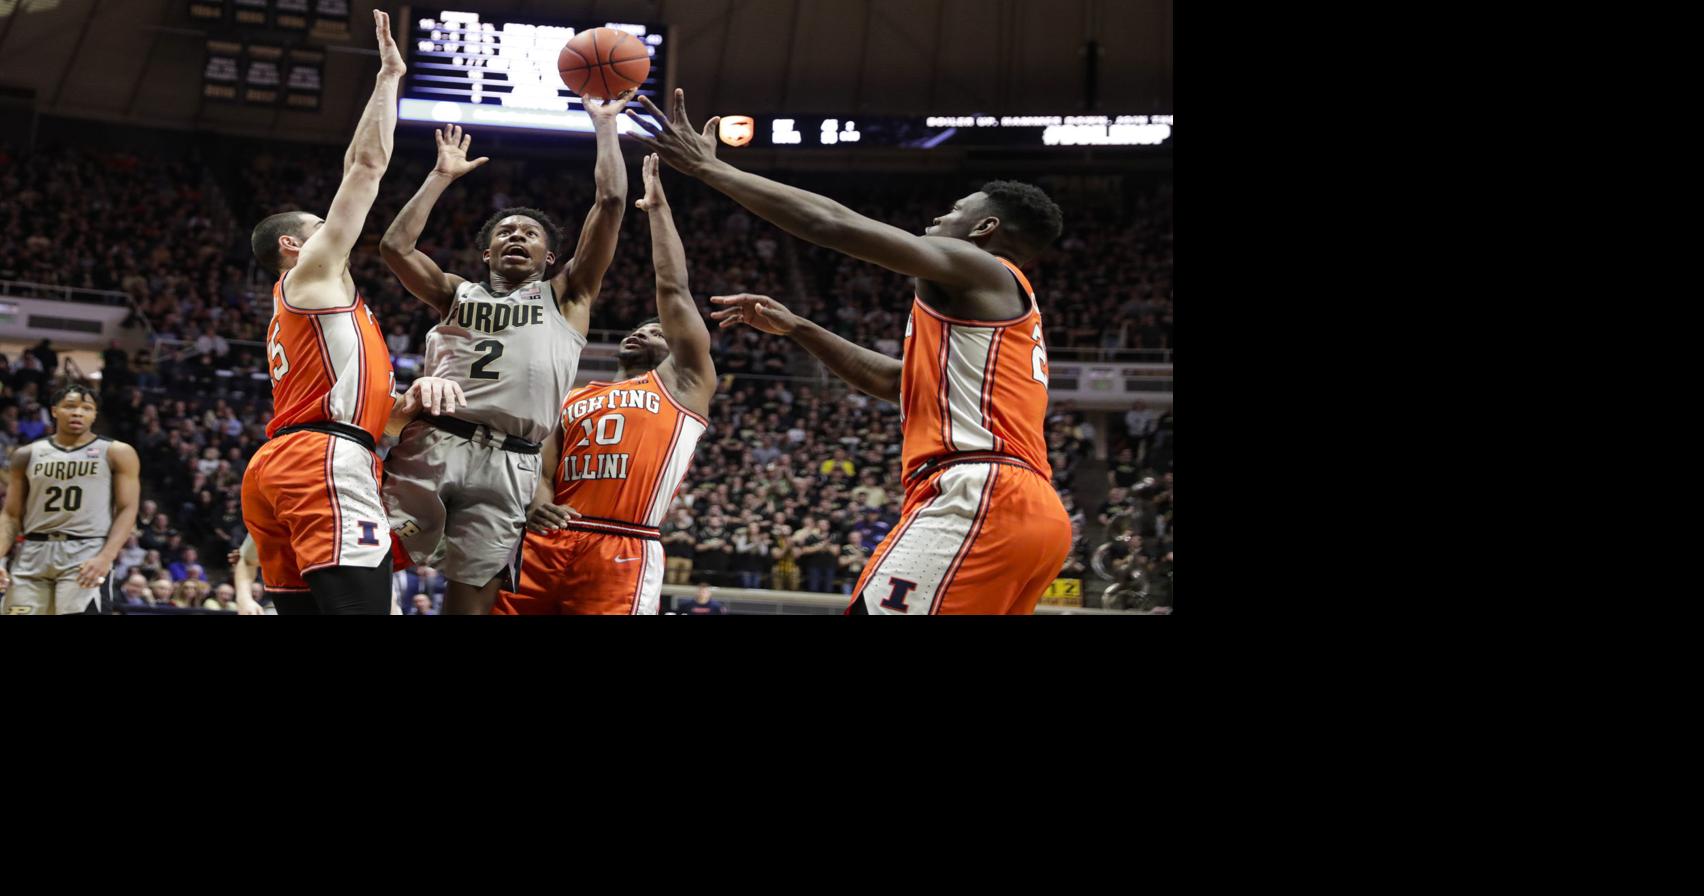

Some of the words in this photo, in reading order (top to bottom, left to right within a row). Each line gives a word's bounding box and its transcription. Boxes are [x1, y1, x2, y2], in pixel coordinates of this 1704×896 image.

[469, 339, 504, 380] 2
[577, 413, 625, 446] 10
[34, 460, 99, 481] PURDUE
[564, 453, 629, 481] ILLINI
[44, 485, 82, 512] 20
[358, 520, 379, 546] I
[880, 576, 917, 613] I
